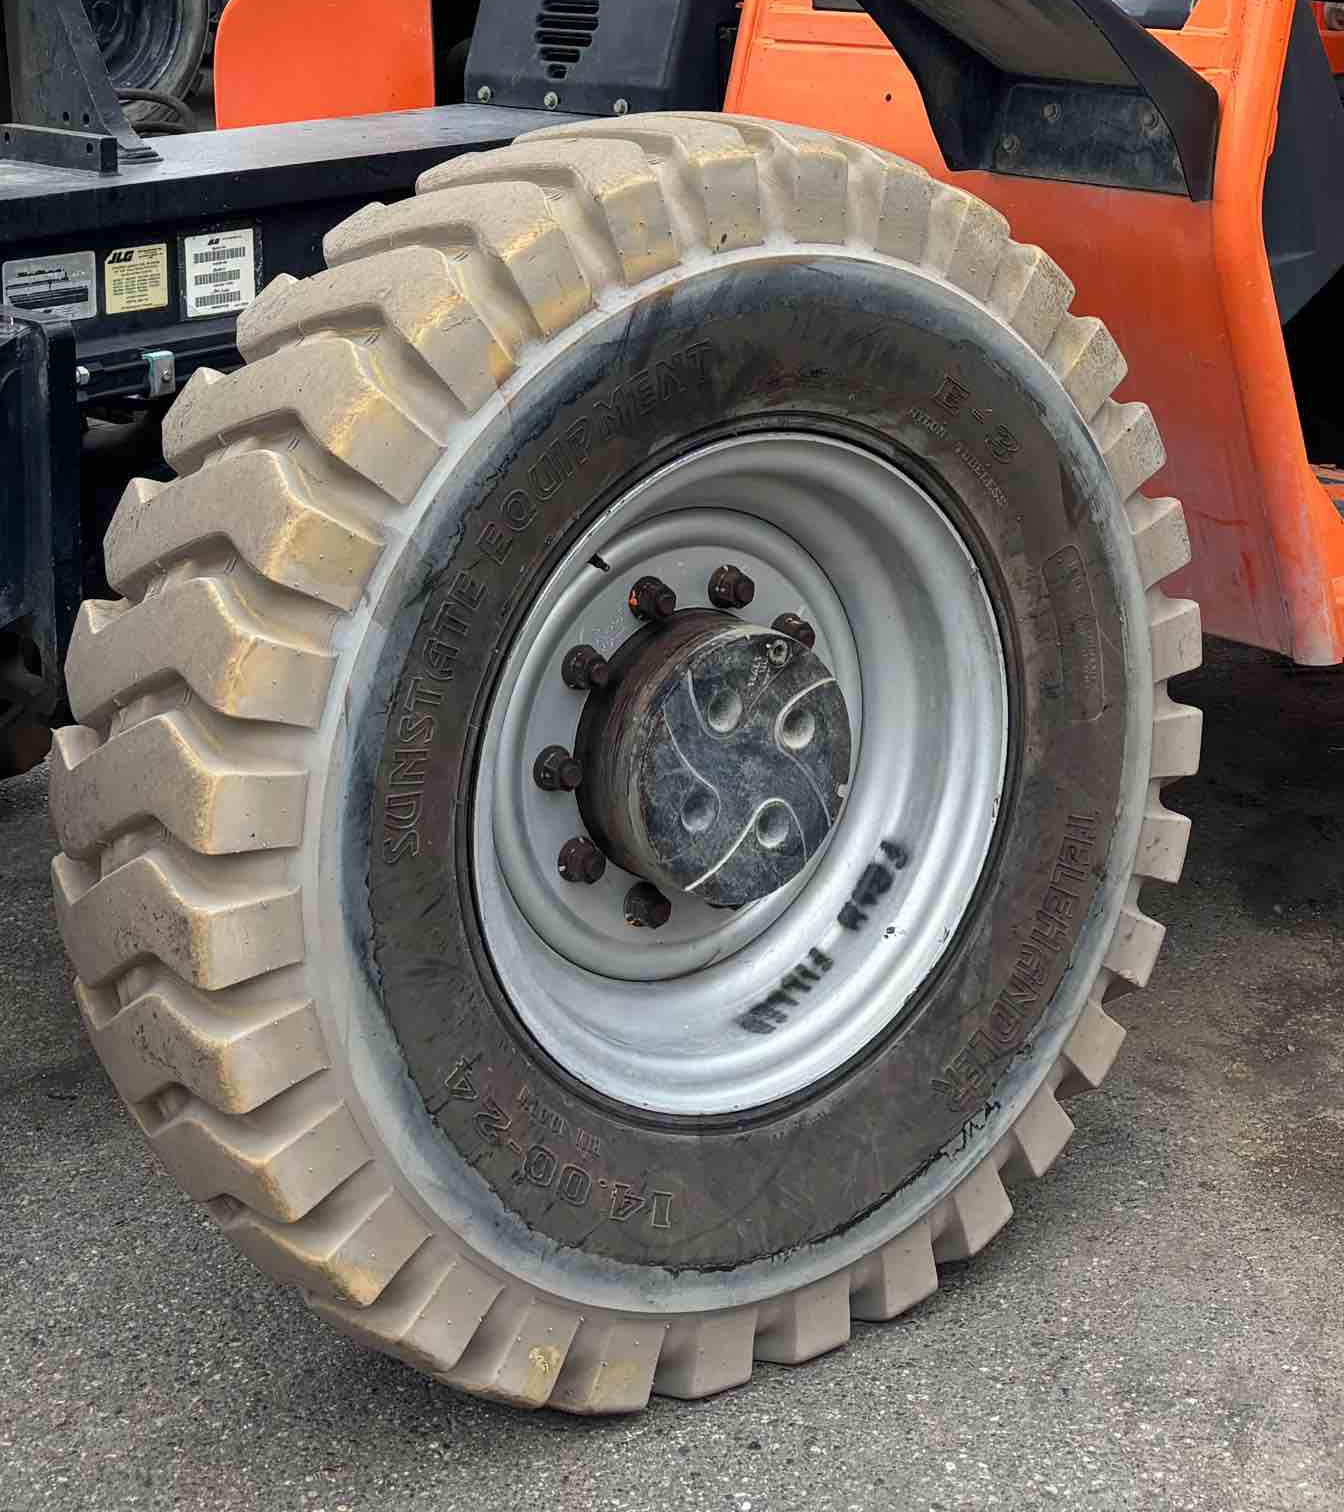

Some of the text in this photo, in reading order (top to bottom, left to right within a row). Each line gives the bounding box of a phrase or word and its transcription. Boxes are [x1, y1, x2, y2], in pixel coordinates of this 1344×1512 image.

[107, 250, 134, 264] JLG
[382, 338, 715, 866] SUNSTATE EQUIPMENT
[930, 808, 1103, 1114] TELEHANDLER
[444, 1053, 674, 1228] 14.00-24
